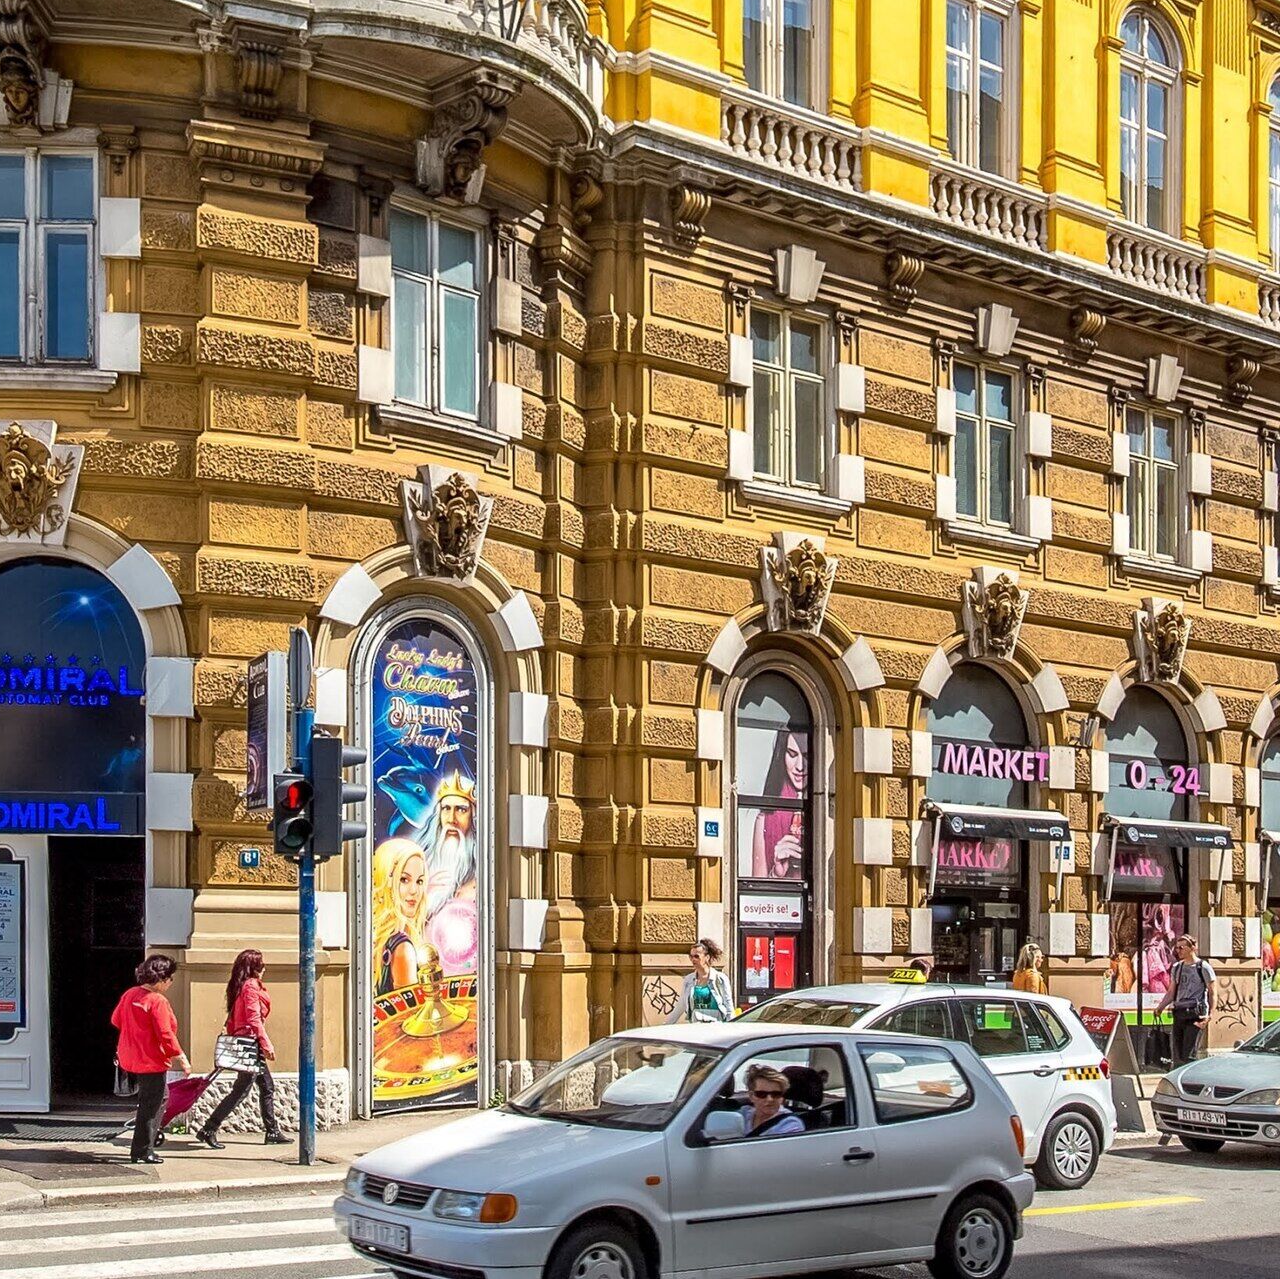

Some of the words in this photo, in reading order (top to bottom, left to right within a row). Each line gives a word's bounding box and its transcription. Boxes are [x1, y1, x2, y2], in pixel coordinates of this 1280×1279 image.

[386, 643, 425, 666] Lucky
[383, 662, 458, 696] Charm
[69, 694, 110, 707] CLUB
[942, 742, 1050, 782] MARKET
[1129, 760, 1147, 790] 0
[1172, 765, 1201, 796] 24
[744, 901, 774, 915] osvježi
[776, 903, 789, 914] se!
[891, 970, 917, 979] TAXI
